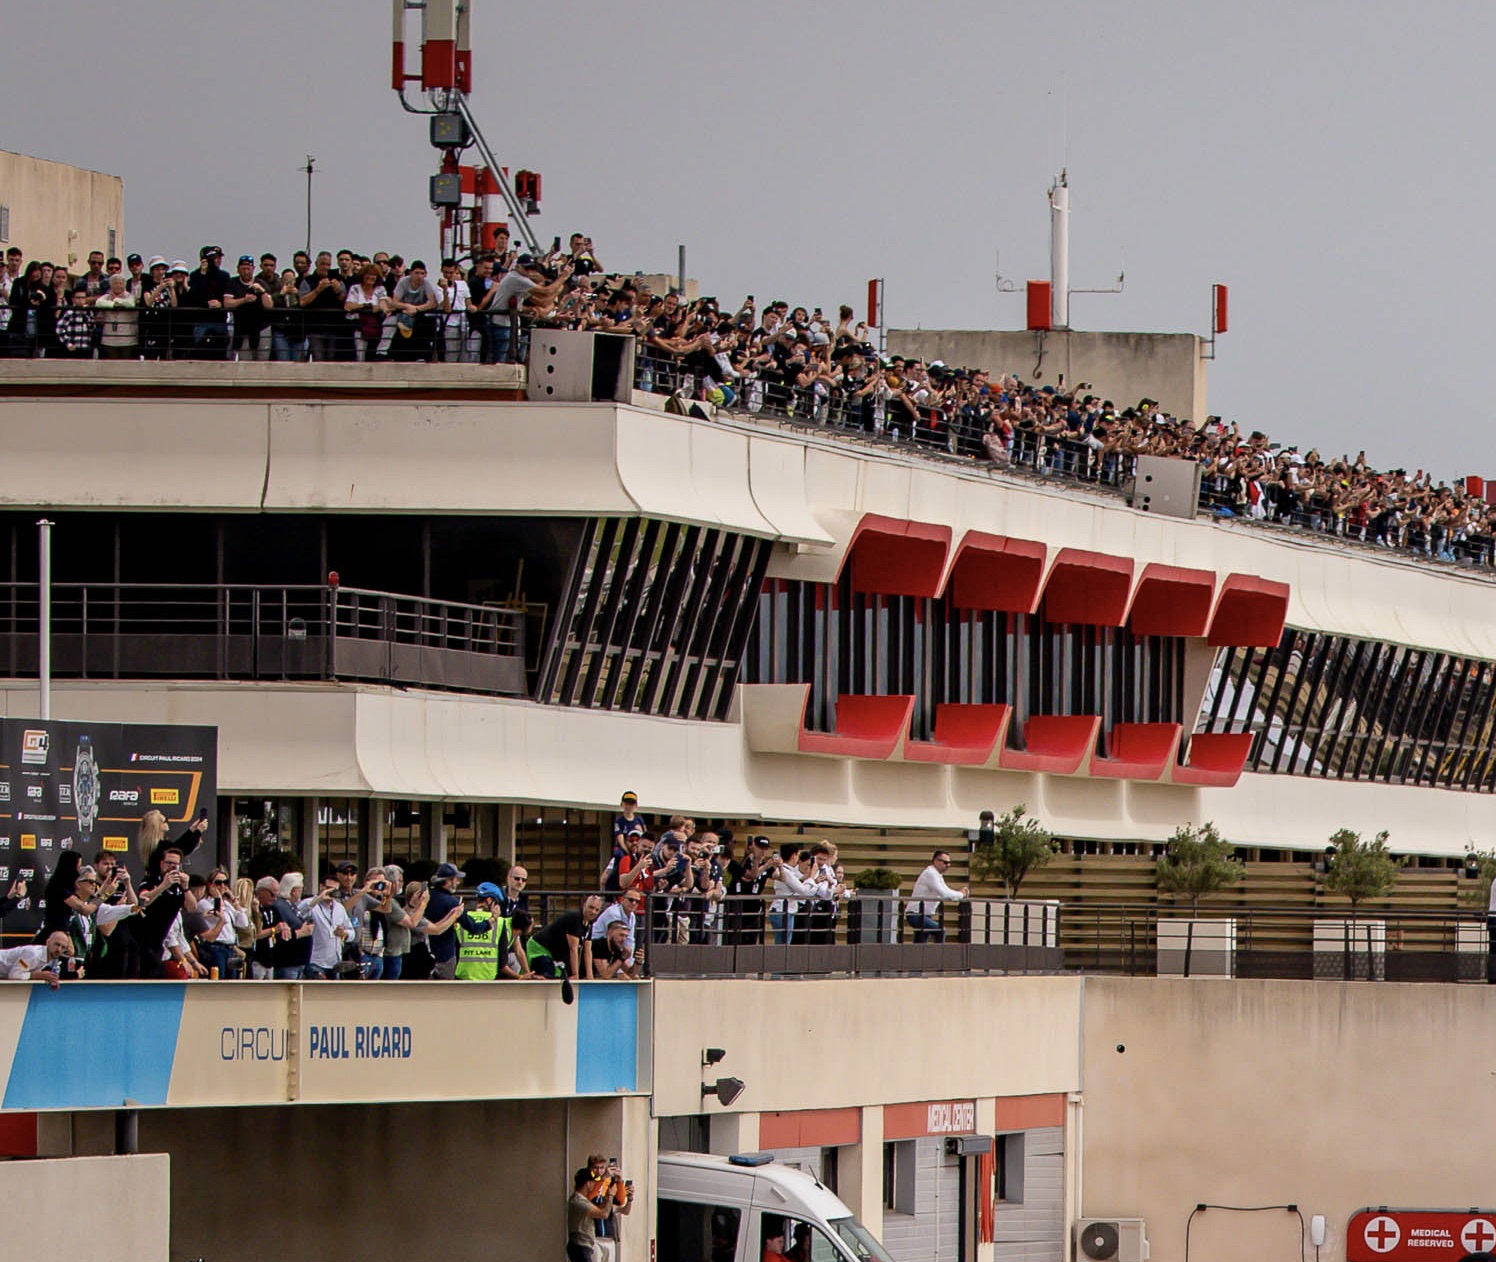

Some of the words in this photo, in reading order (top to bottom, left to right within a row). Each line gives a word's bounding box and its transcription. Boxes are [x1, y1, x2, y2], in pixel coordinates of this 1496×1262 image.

[221, 1027, 288, 1061] CIRCUI
[310, 1026, 349, 1059] PAUL
[355, 1026, 412, 1059] RICARD
[1411, 1229, 1451, 1238] MEDICAL
[1407, 1238, 1454, 1248] RESERVED
